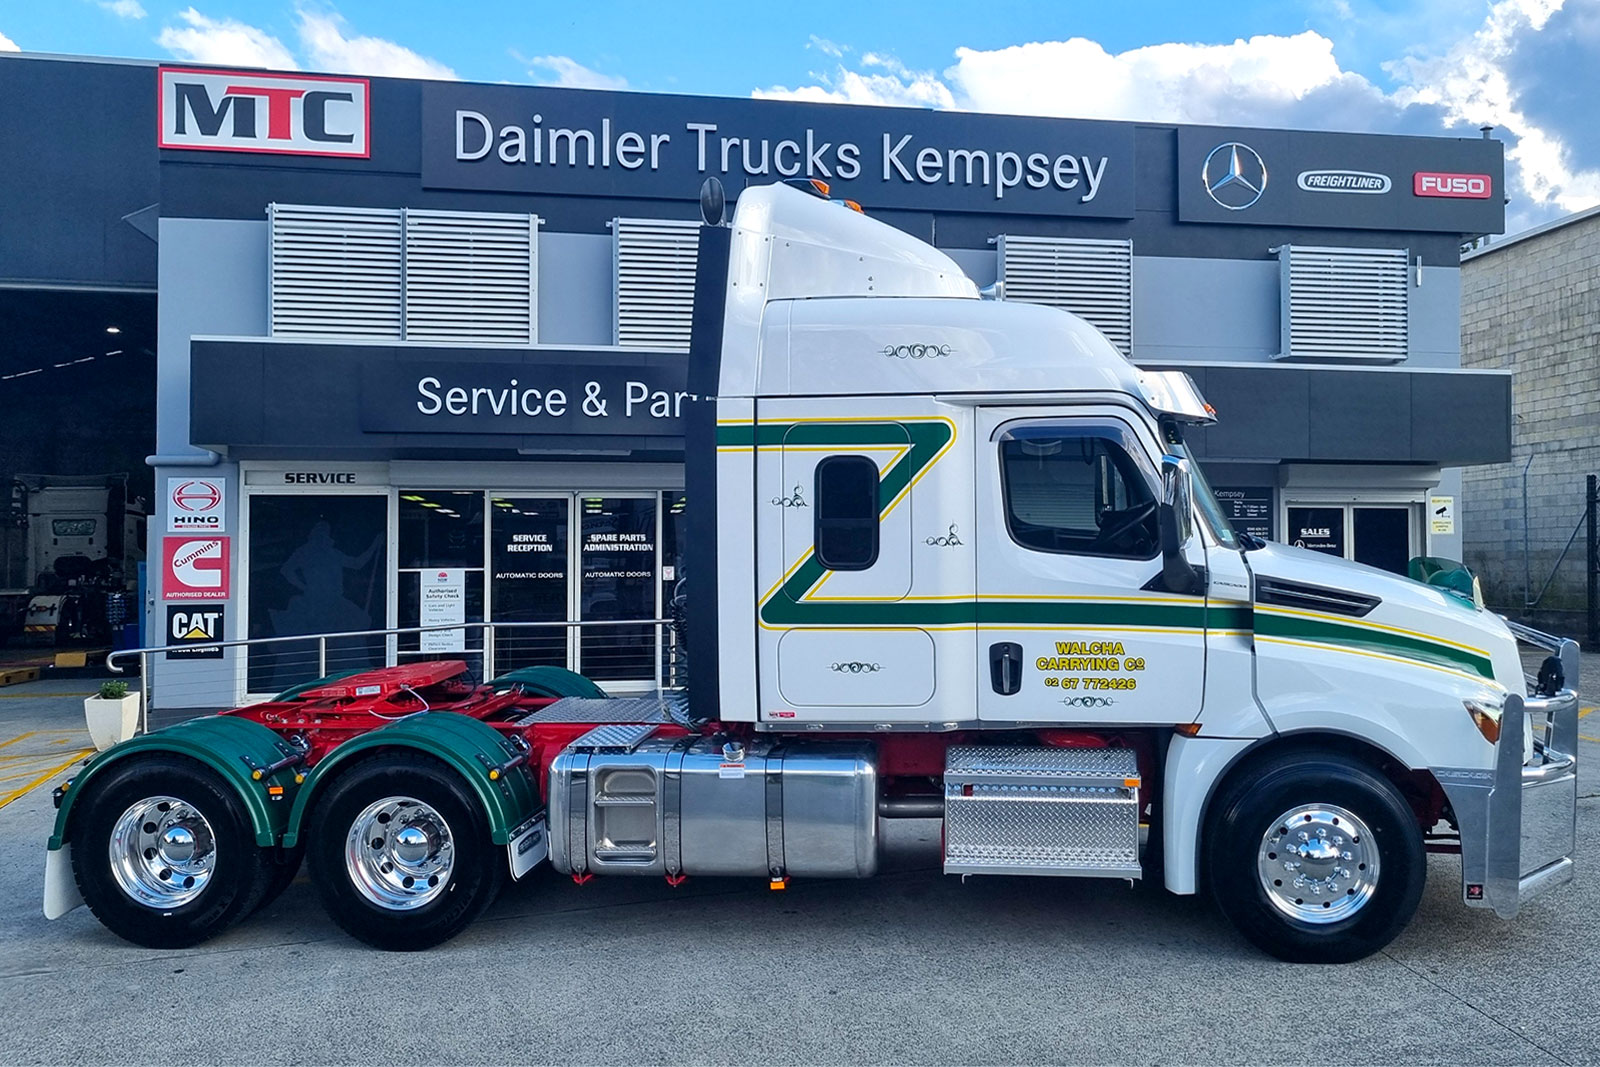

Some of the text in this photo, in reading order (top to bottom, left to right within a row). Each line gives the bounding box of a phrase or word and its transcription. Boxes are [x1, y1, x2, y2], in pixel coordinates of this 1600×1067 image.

[174, 83, 354, 143] MTC
[456, 110, 1108, 202] Daimler Trucks Kempsey
[1307, 175, 1382, 189] FREIGHTLINER
[1422, 176, 1484, 194] FUSO
[417, 377, 688, 418] Service & Par
[285, 472, 356, 484] SERVICE
[1214, 490, 1245, 499] Kempsey
[512, 534, 547, 542] SERVICE
[591, 534, 647, 542] SPARE PARTS
[507, 544, 553, 552] RECEPTION
[583, 543, 654, 551] ADMINISTRATION
[173, 540, 219, 568] Cummins
[172, 612, 219, 638] CAT
[1055, 642, 1125, 655] WALCHA
[1036, 657, 1119, 671] CARRYING
[1045, 677, 1137, 690] 02 67 772426
